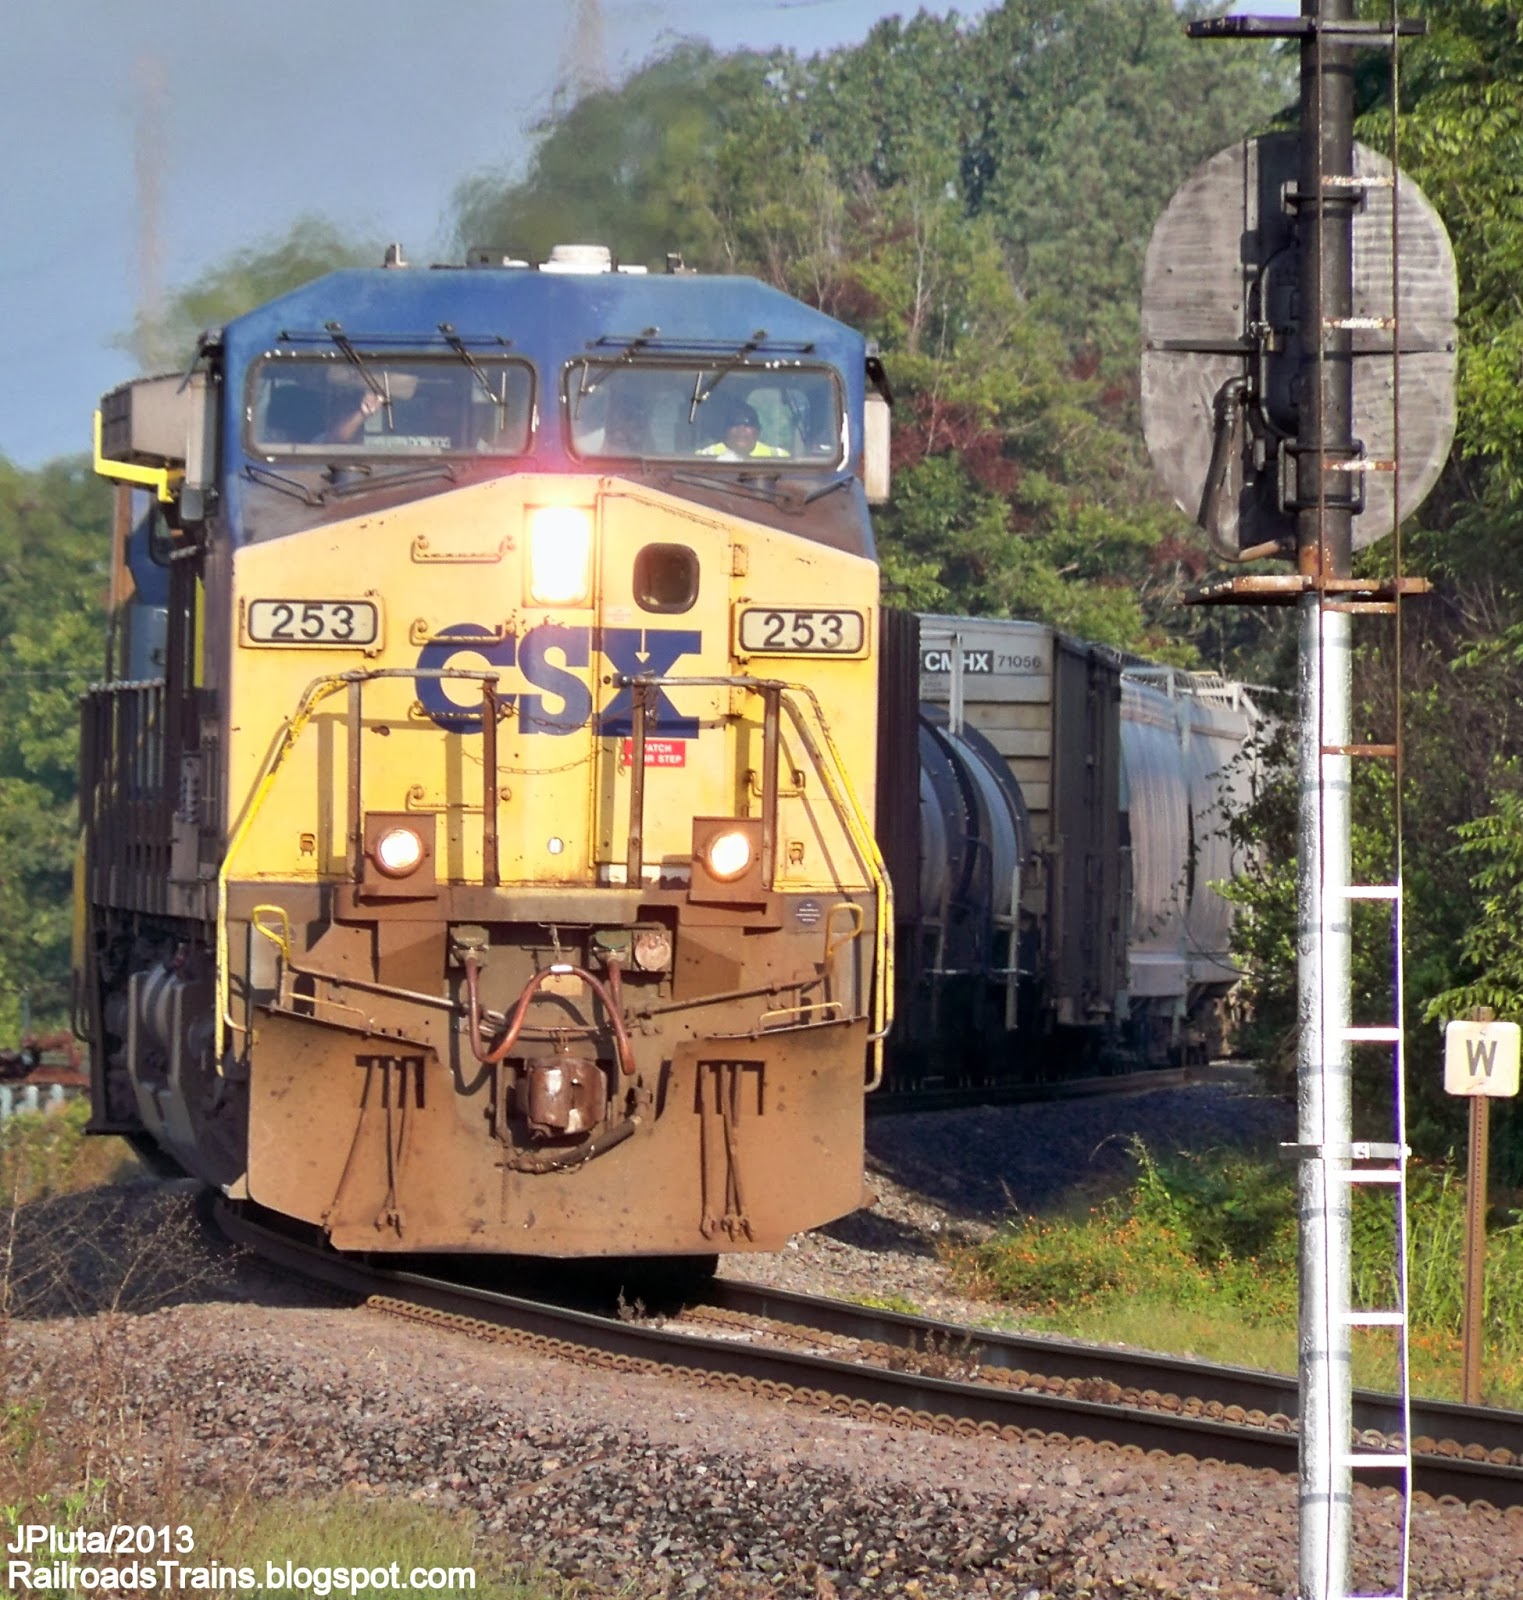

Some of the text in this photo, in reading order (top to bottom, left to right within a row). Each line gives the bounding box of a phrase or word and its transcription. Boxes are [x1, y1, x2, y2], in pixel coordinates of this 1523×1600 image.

[271, 603, 354, 639] 253
[763, 613, 843, 648] 253
[415, 622, 701, 738] CSX
[644, 743, 672, 753] ATCH
[658, 754, 682, 763] STEP
[1466, 1040, 1497, 1076] W
